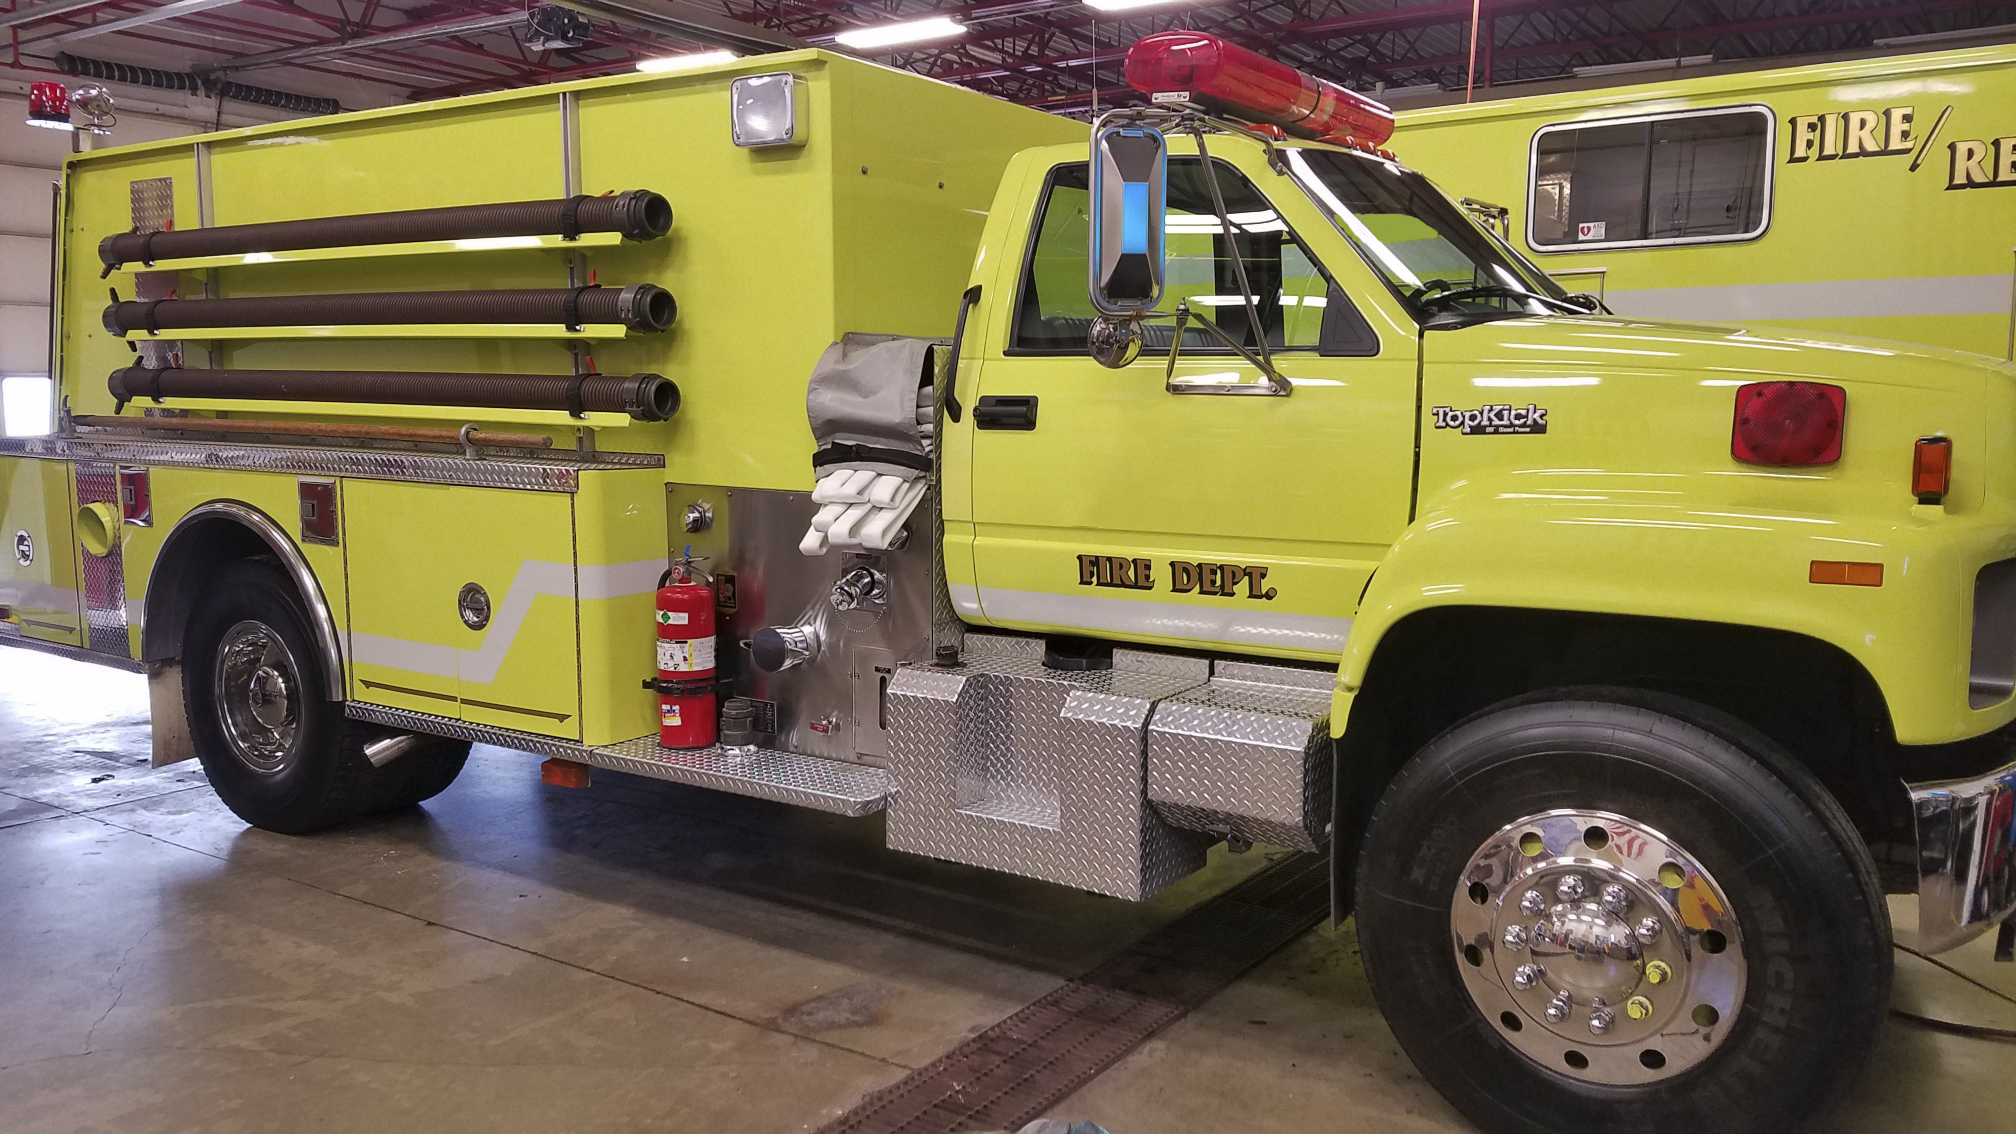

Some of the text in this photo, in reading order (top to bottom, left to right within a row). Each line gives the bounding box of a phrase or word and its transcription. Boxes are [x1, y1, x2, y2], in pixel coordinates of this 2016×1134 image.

[1432, 404, 1547, 434] TopKick
[1076, 554, 1278, 601] FIRE DEPT.
